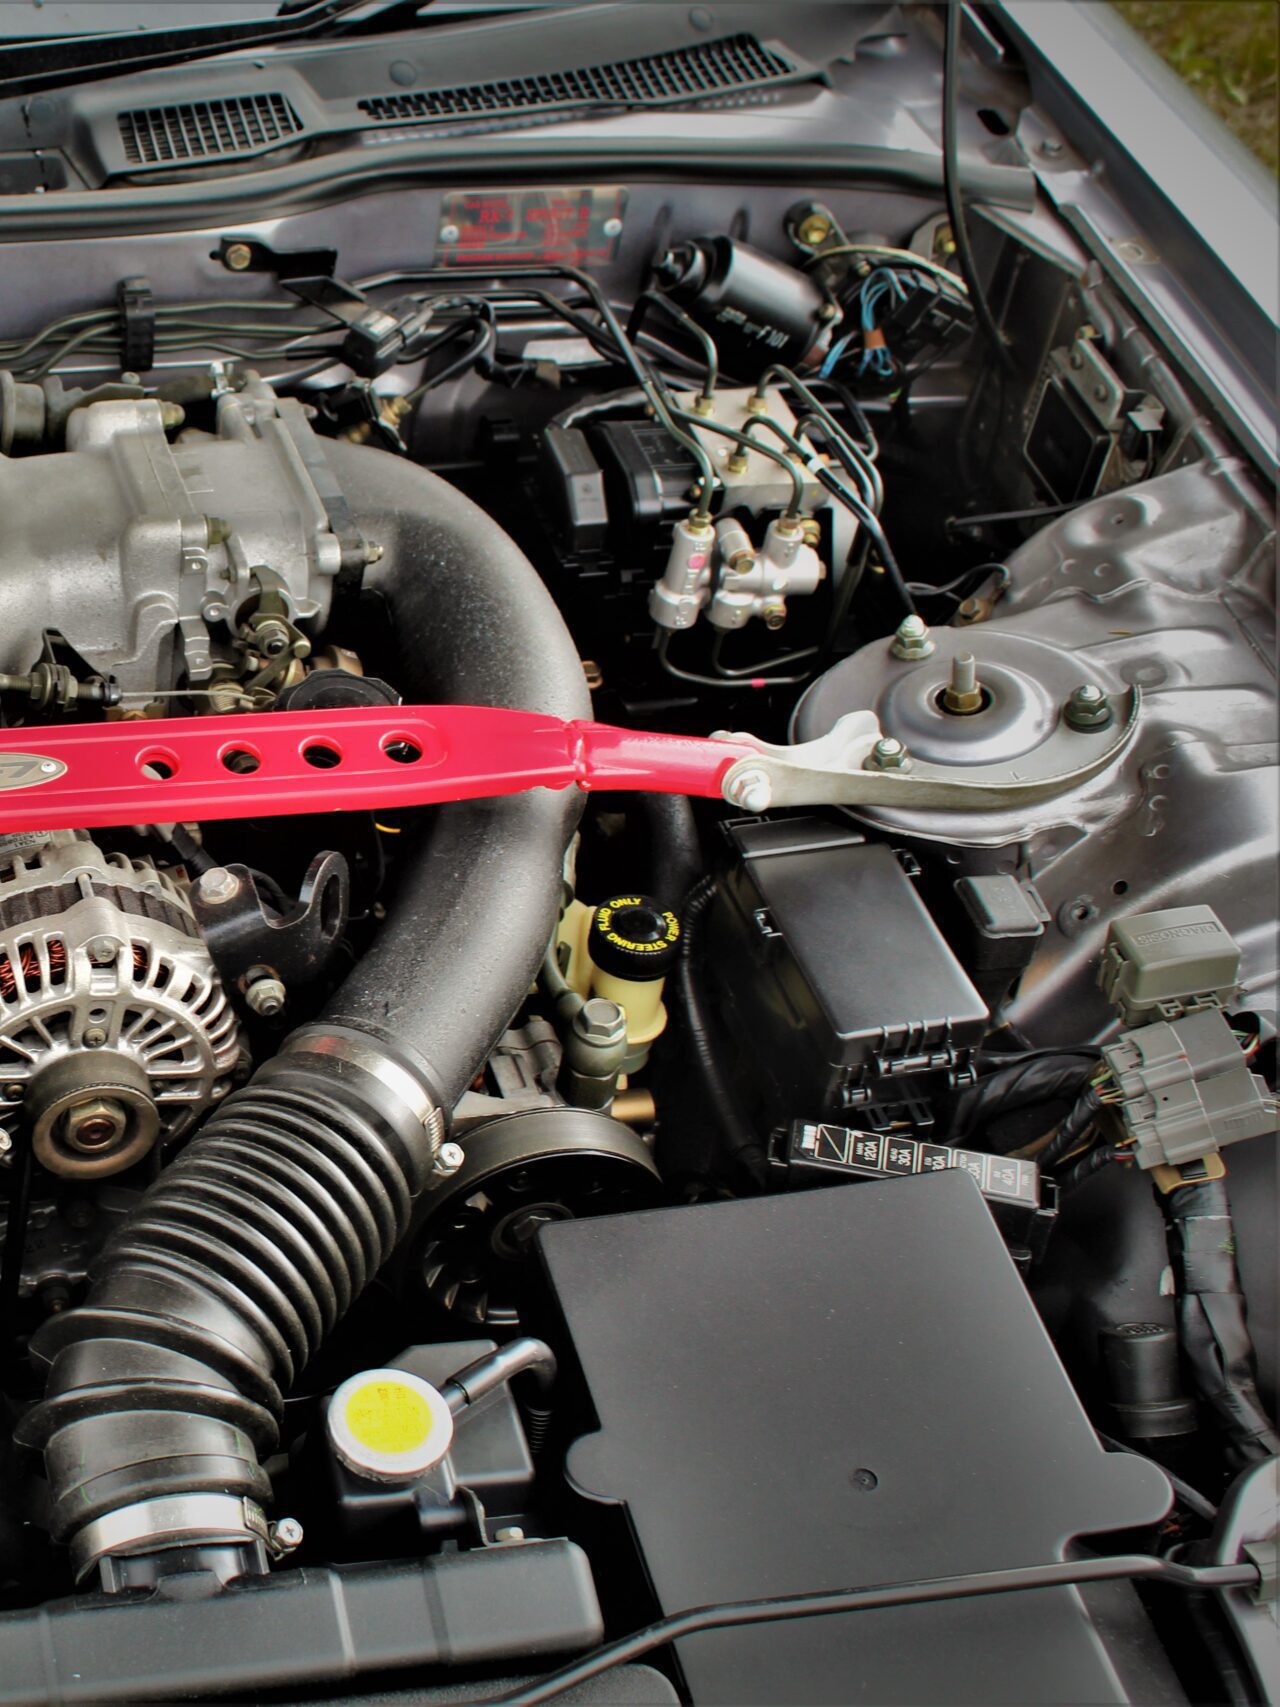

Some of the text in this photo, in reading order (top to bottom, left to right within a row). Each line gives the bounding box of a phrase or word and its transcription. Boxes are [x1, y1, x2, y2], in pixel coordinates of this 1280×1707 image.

[597, 897, 681, 952] POWER STEERING FLUID ONLY
[1135, 924, 1216, 945] DIAGNOSIS
[864, 1141, 878, 1161] 120A
[898, 1148, 912, 1167] 30A
[1001, 1167, 1015, 1187] 40A
